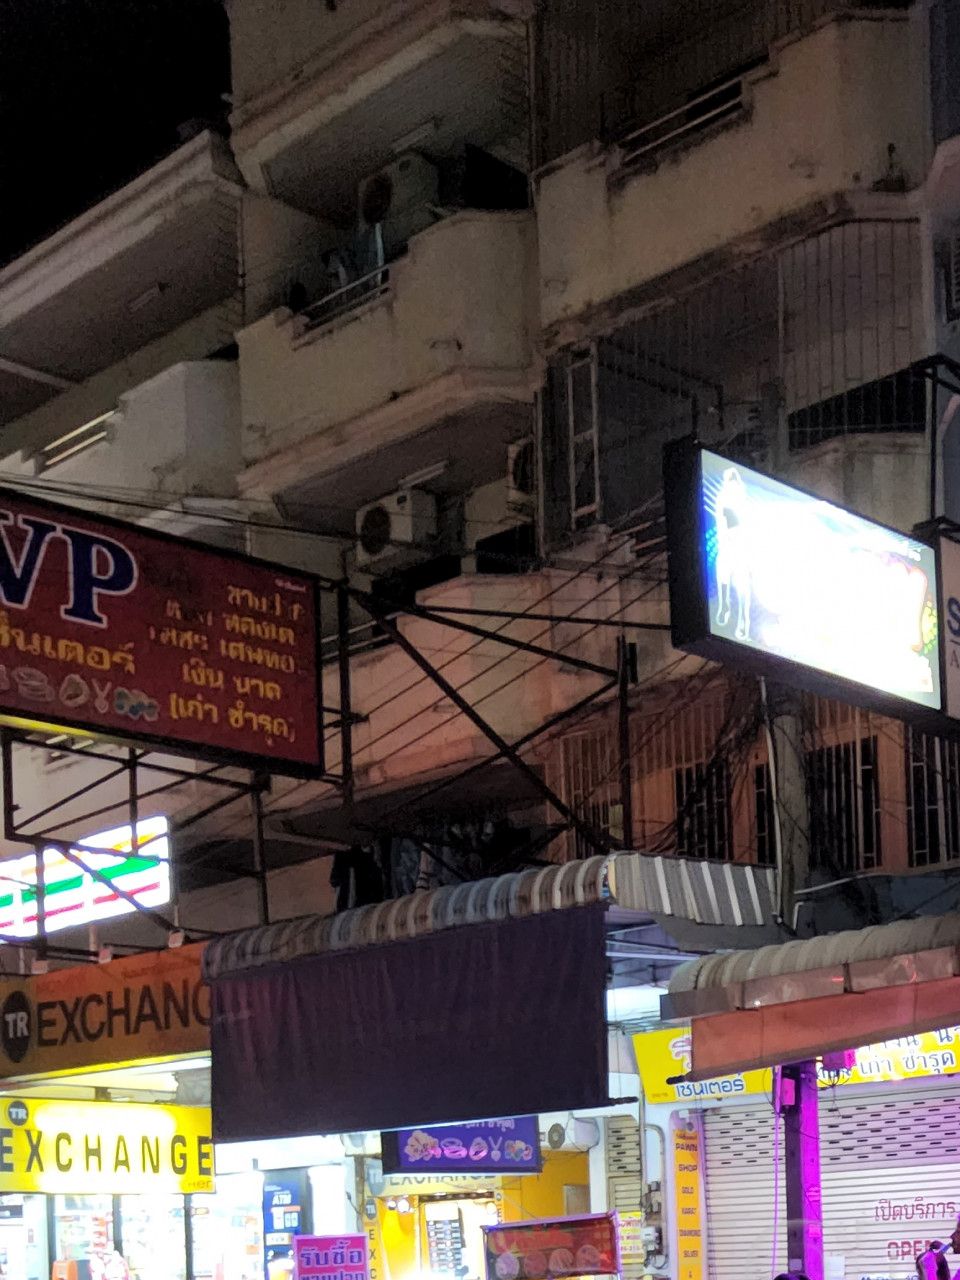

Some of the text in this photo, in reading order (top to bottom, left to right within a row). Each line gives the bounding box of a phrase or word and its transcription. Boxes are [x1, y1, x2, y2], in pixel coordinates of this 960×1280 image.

[4, 1012, 29, 1037] TR
[0, 1128, 212, 1177] EXCHANGE
[678, 1163, 698, 1172] SHOP
[874, 1196, 956, 1222] เปิดบริการ
